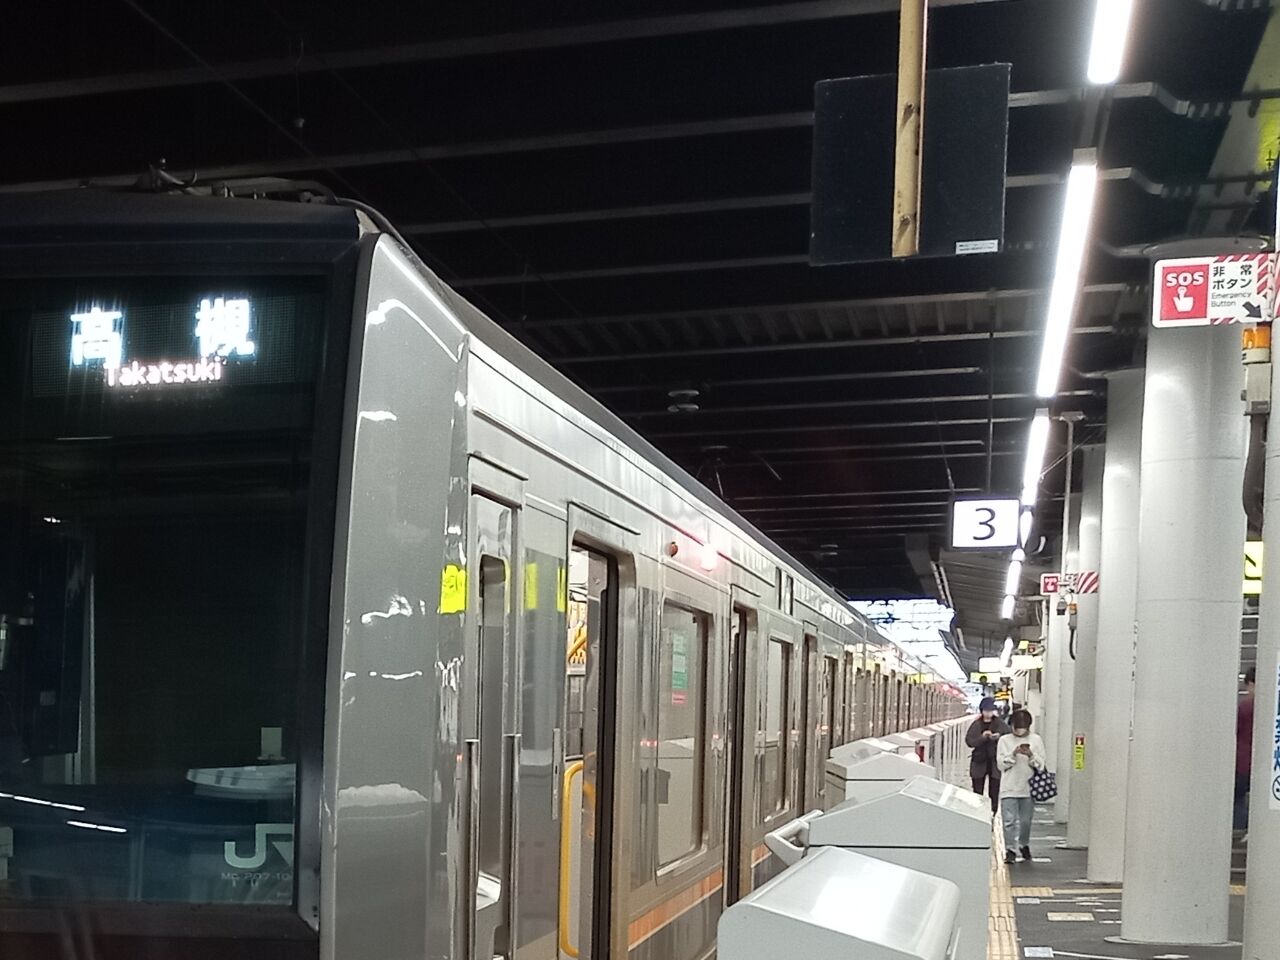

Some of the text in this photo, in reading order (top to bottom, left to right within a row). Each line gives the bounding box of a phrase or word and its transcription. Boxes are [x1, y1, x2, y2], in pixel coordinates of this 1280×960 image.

[1213, 264, 1252, 277] 非常
[1166, 271, 1204, 287] SOS
[1212, 278, 1252, 290] ボタン
[1210, 291, 1252, 301] Emergency
[1210, 300, 1237, 308] Button
[106, 356, 222, 386] Takatsuki
[972, 508, 997, 540] 3
